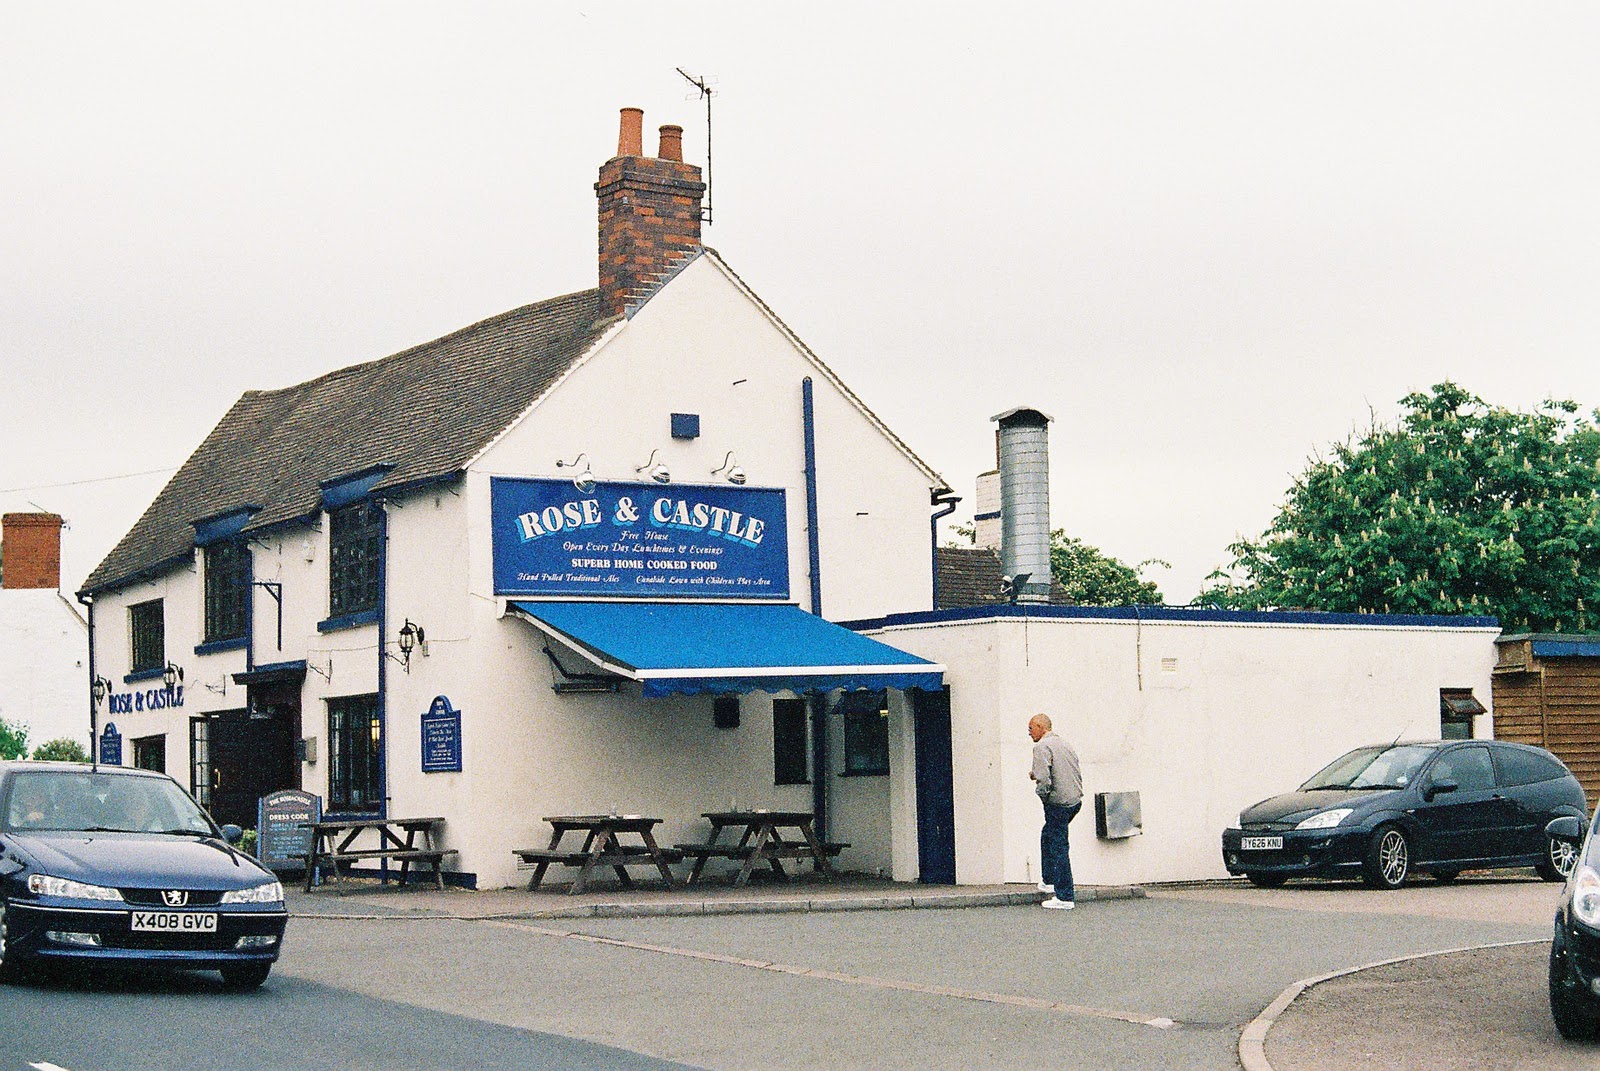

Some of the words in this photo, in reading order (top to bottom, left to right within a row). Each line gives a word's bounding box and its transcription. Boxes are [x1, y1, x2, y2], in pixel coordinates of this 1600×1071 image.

[516, 499, 602, 541] ROSE
[613, 496, 640, 524] &
[652, 497, 766, 546] CASTLE
[619, 530, 640, 541] Free
[644, 530, 669, 541] House
[562, 541, 583, 552] Open
[586, 542, 609, 552] Every
[611, 542, 629, 553] Day
[689, 544, 723, 555] Evenings
[571, 558, 611, 569] SUPERB
[614, 559, 644, 569] HOME
[646, 560, 688, 570] COOKED
[690, 561, 718, 571] FOOD
[517, 572, 539, 581] Hand
[541, 573, 563, 582] Pulled
[565, 573, 601, 583] Traditional
[603, 574, 620, 583] Ales
[690, 576, 704, 585] with
[108, 693, 133, 714] ROSE
[135, 691, 145, 712] &
[146, 685, 184, 711] CASTLE
[290, 813, 309, 821] CODE
[1247, 838, 1266, 848] Y626
[134, 913, 179, 929] X408
[183, 914, 214, 929] GVC
